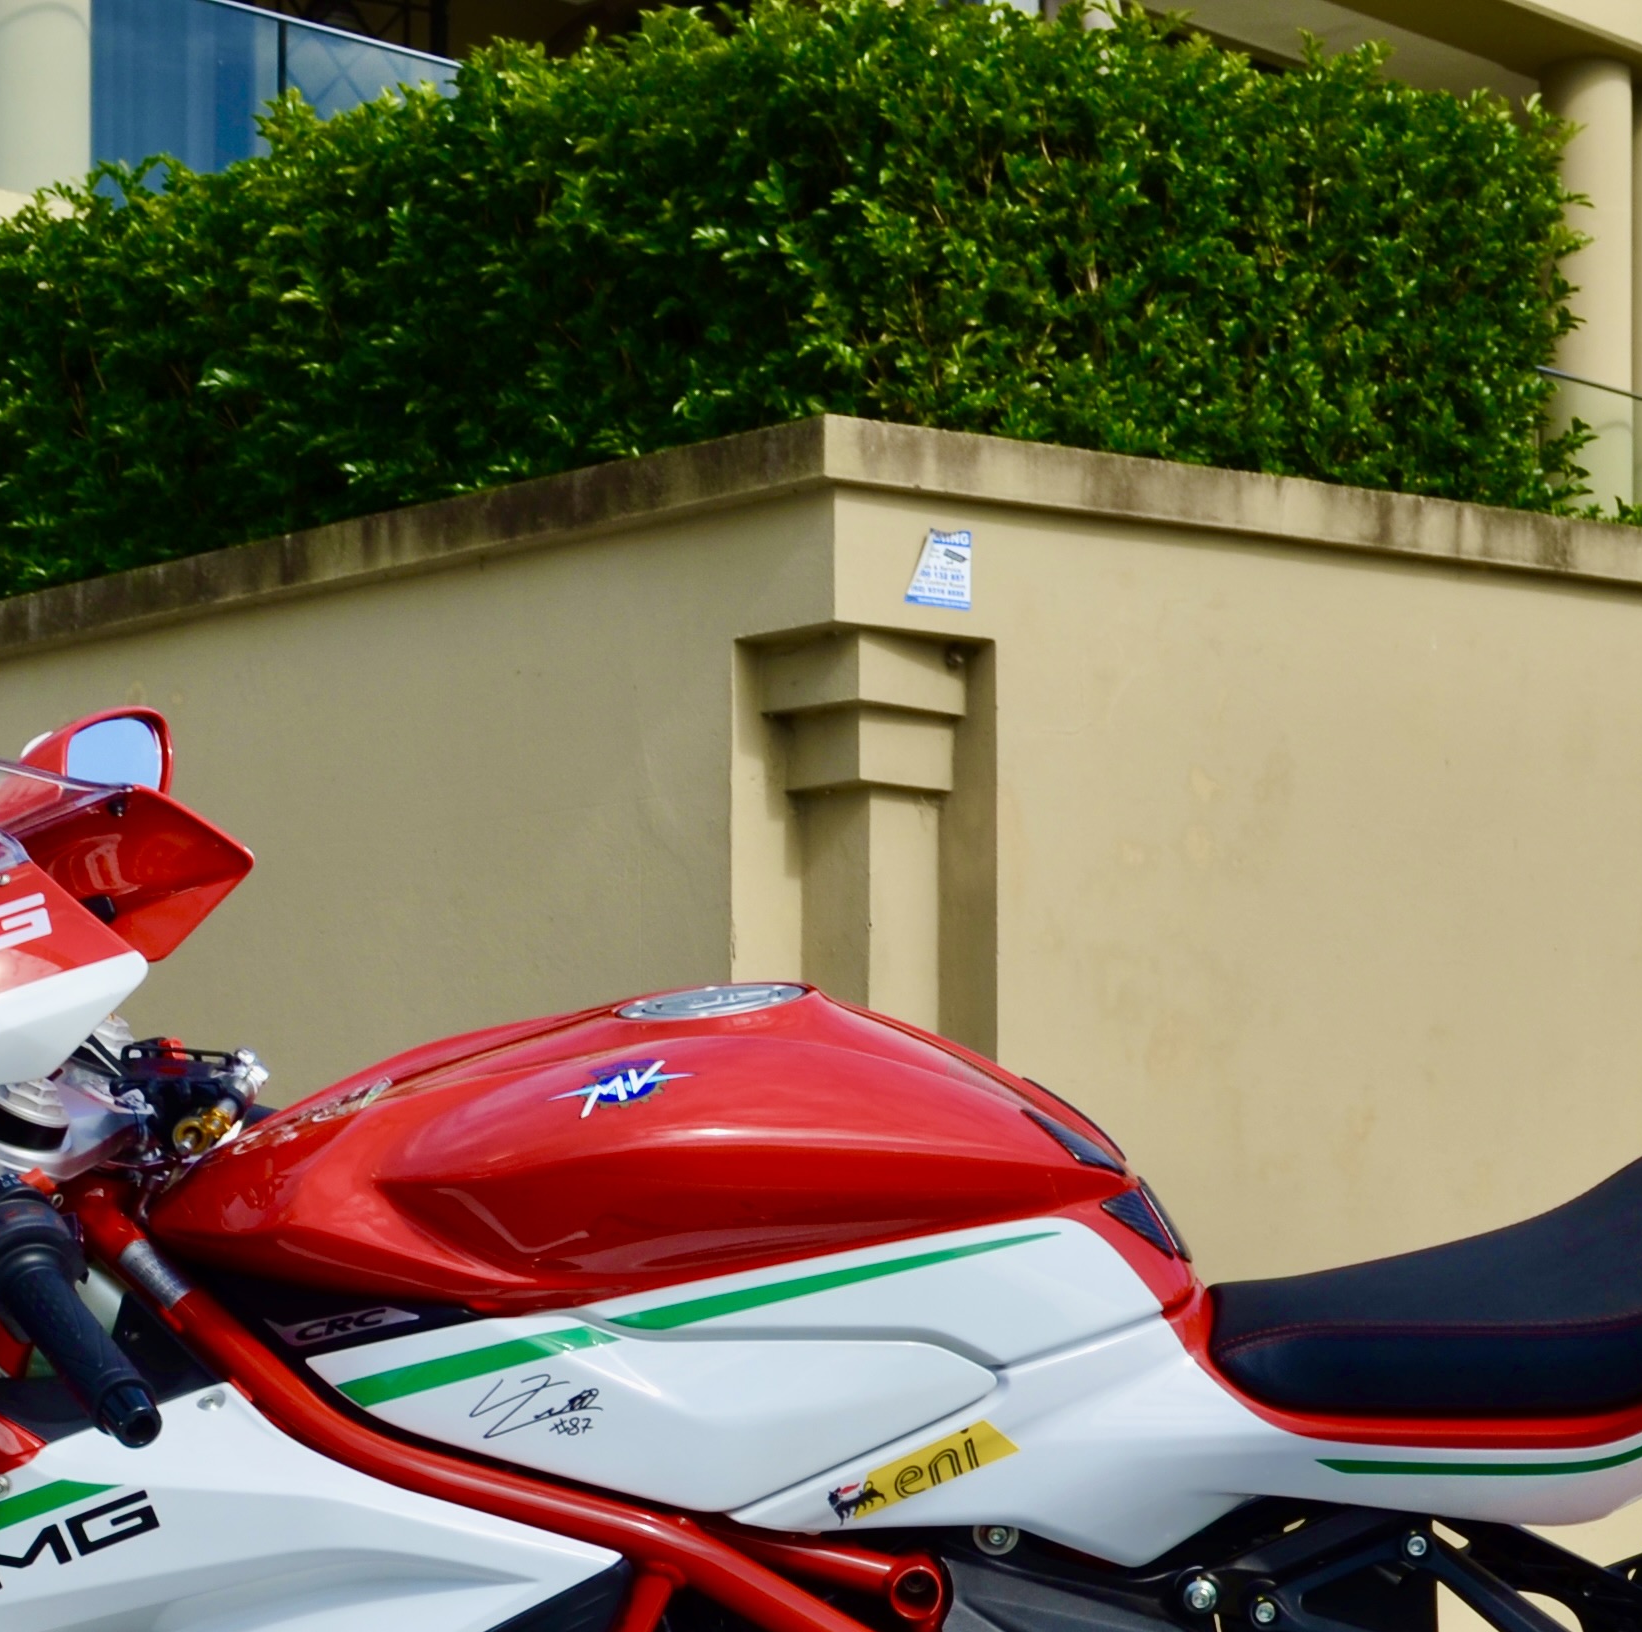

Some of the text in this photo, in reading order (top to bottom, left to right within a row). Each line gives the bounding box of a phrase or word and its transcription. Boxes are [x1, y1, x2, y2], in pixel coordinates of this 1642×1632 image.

[580, 1060, 666, 1119] MV
[295, 1308, 387, 1341] CRC
[894, 1427, 980, 1499] eni
